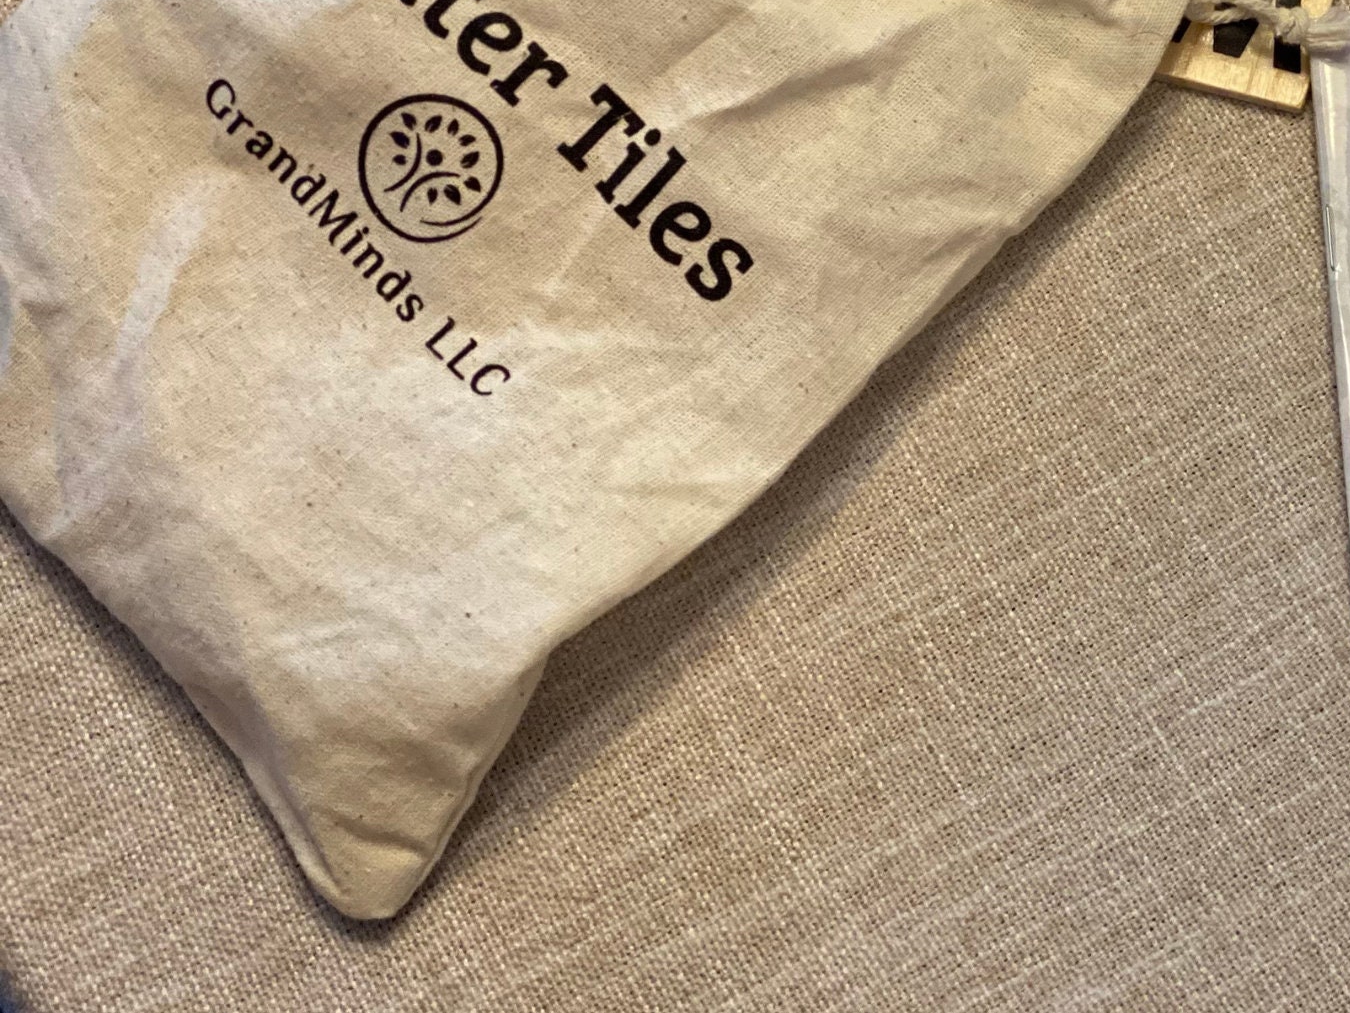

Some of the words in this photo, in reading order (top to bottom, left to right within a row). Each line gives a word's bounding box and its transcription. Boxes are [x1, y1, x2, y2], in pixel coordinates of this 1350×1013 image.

[205, 78, 424, 323] GrandMinds
[424, 316, 512, 396] LLC
[556, 84, 754, 302] Tiles
